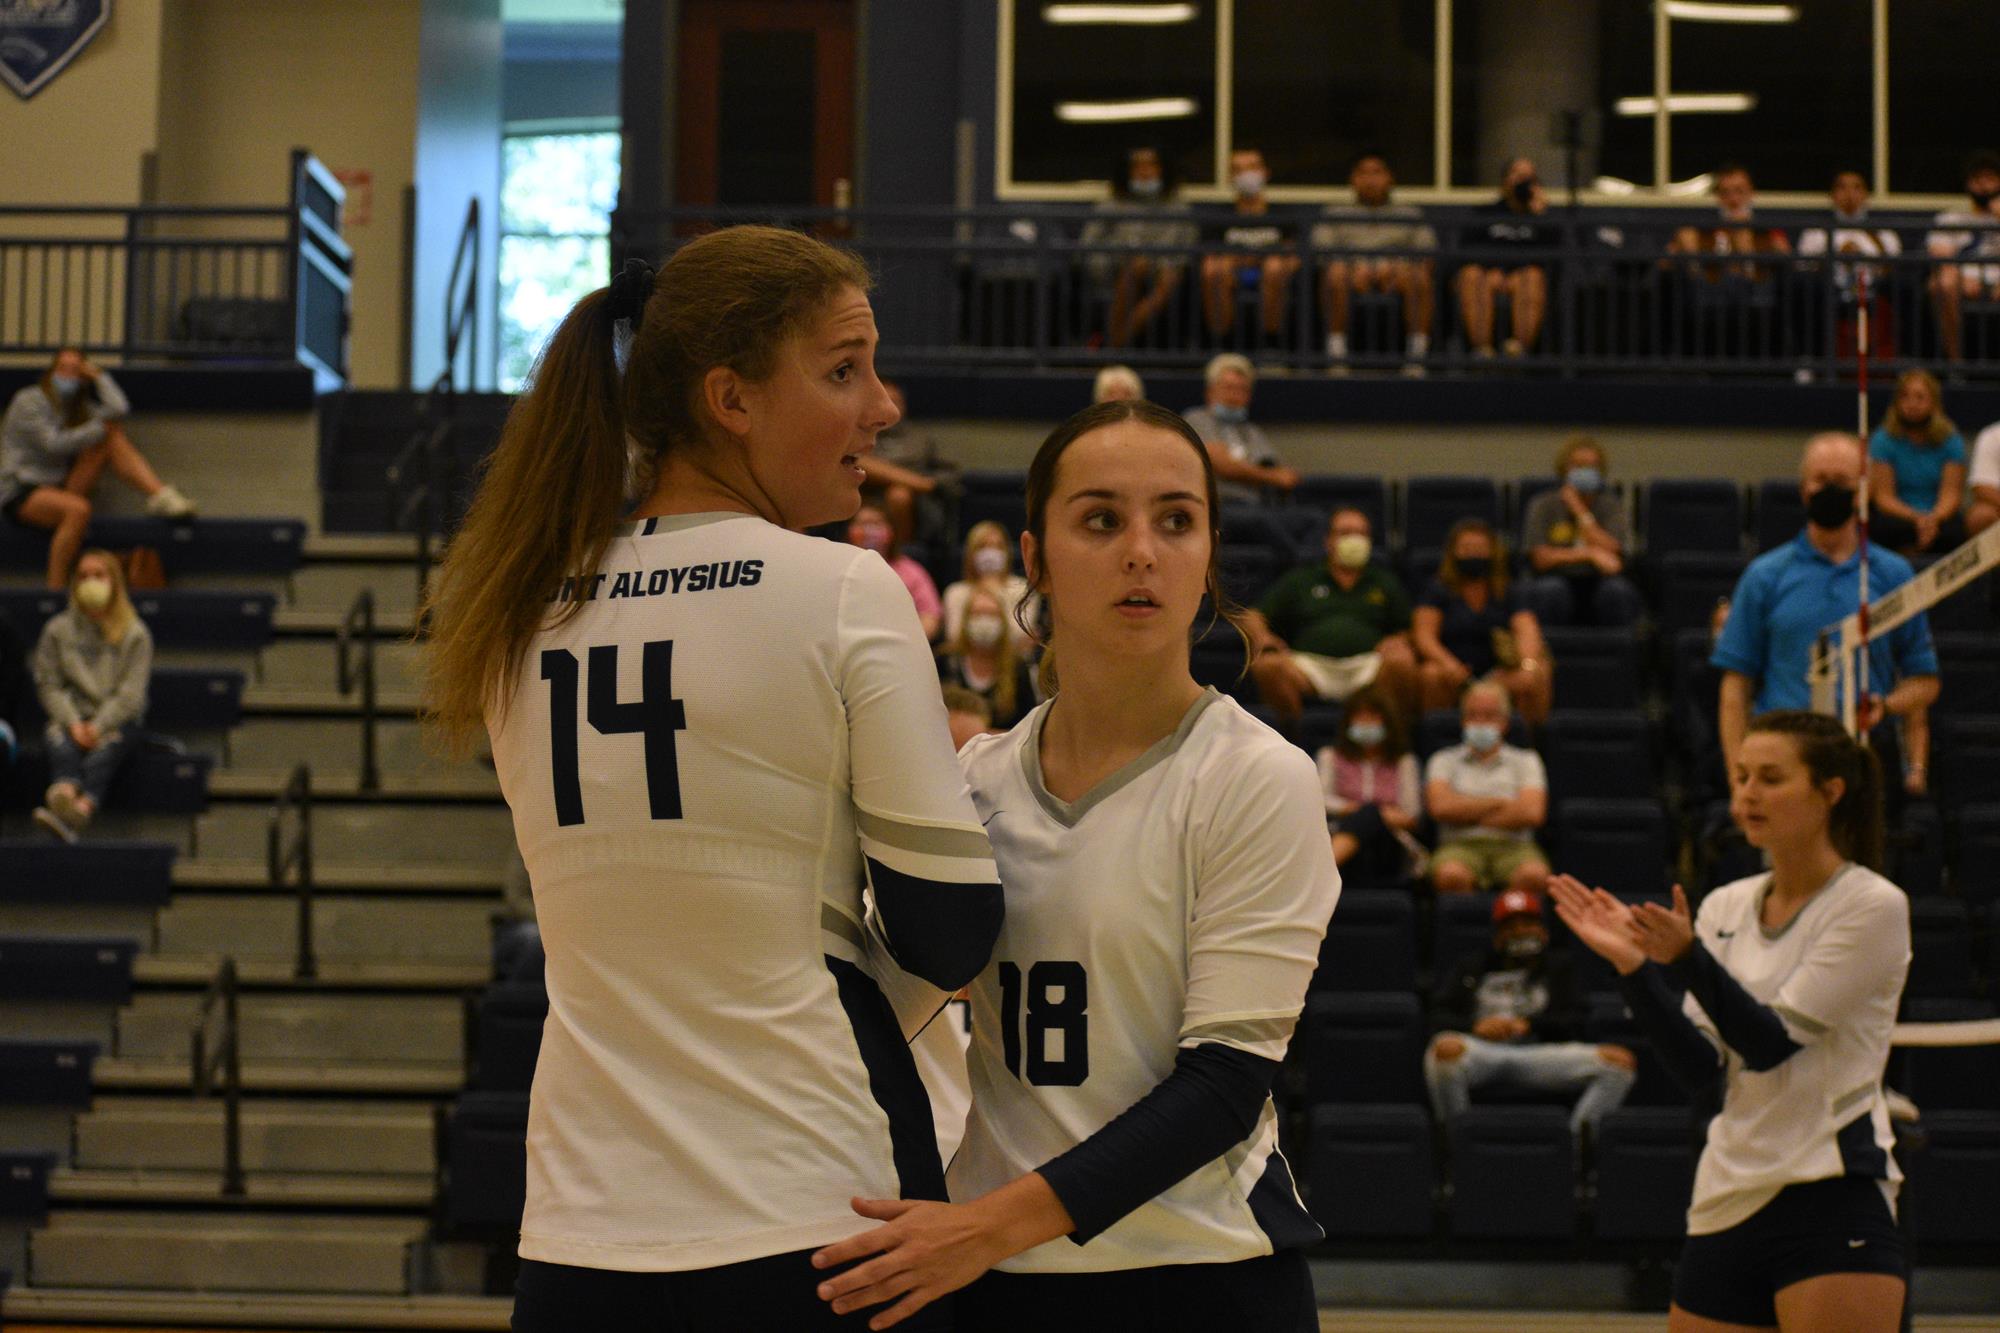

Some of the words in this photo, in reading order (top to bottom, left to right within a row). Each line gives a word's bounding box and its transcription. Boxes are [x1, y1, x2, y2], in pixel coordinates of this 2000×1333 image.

[608, 559, 764, 599] ALOYSIUS
[541, 639, 687, 827] 14
[998, 960, 1089, 1087] 18
